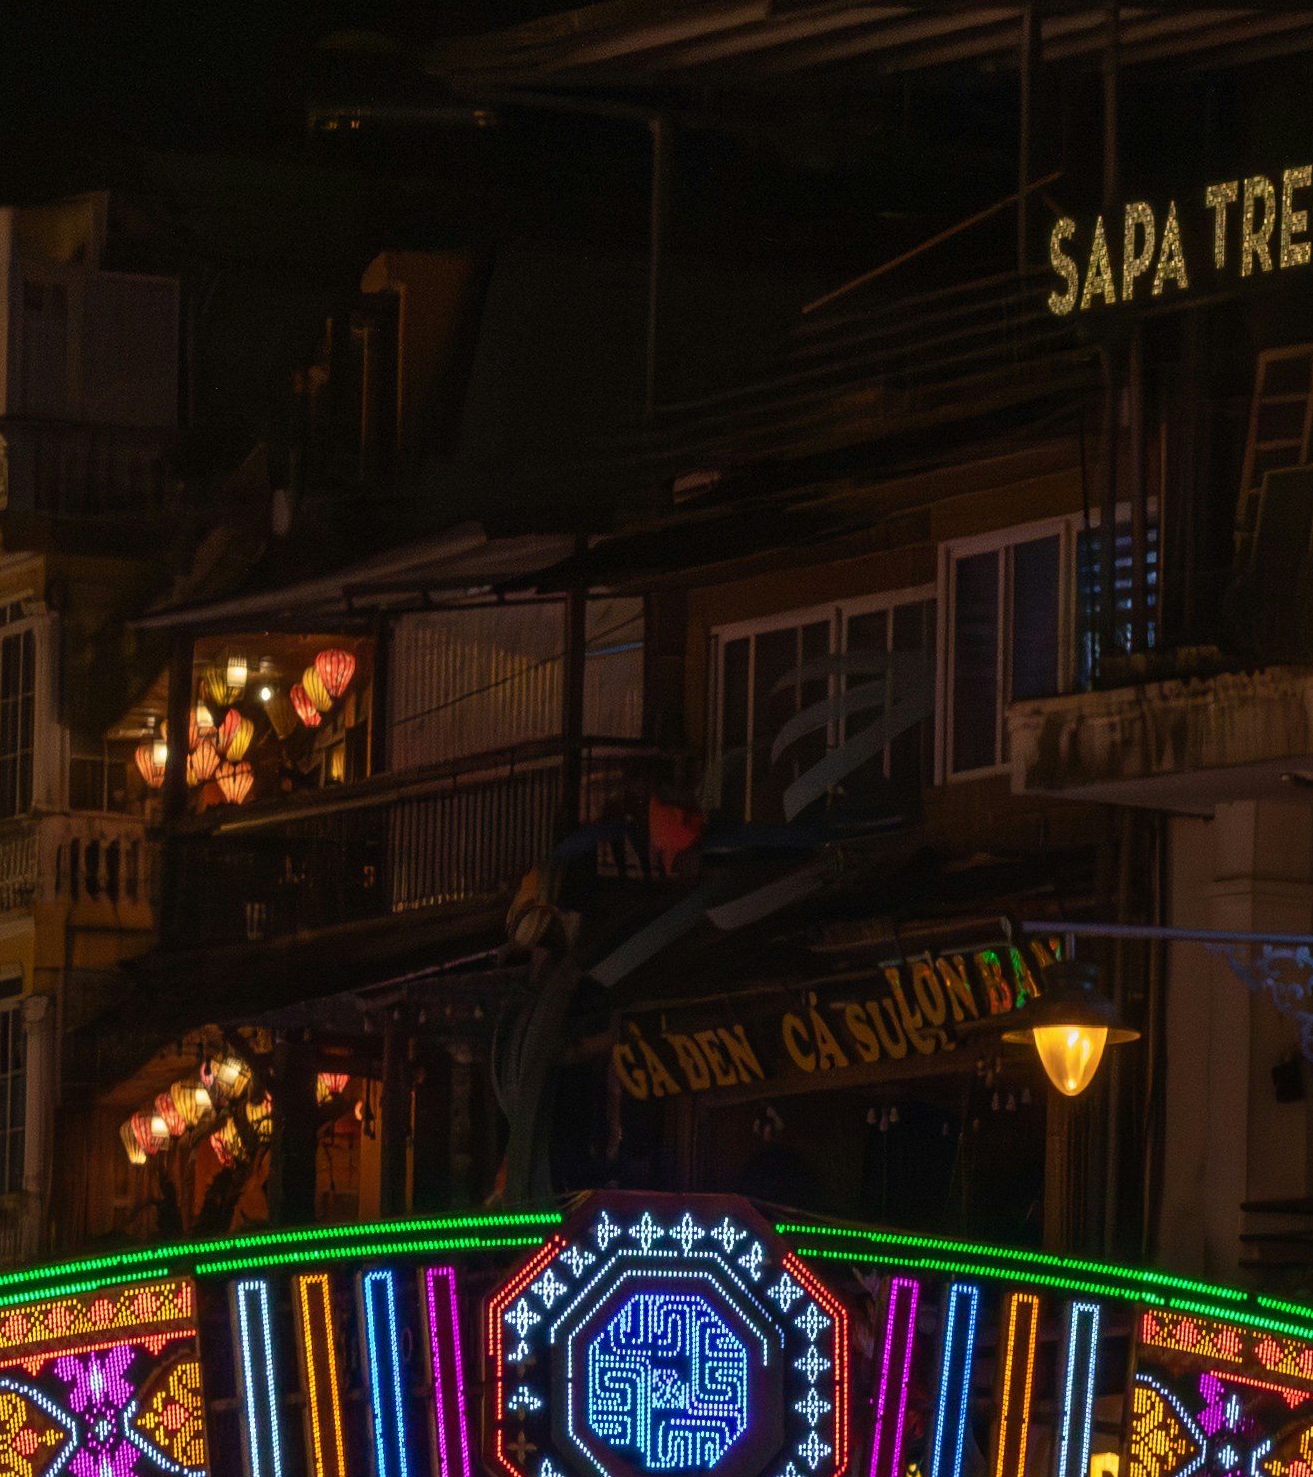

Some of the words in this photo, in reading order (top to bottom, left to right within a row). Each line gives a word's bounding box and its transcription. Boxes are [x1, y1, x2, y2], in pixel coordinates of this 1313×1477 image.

[1046, 200, 1190, 316] SAPA
[665, 1023, 765, 1091] ĐEN
[782, 991, 850, 1072] CÁ
